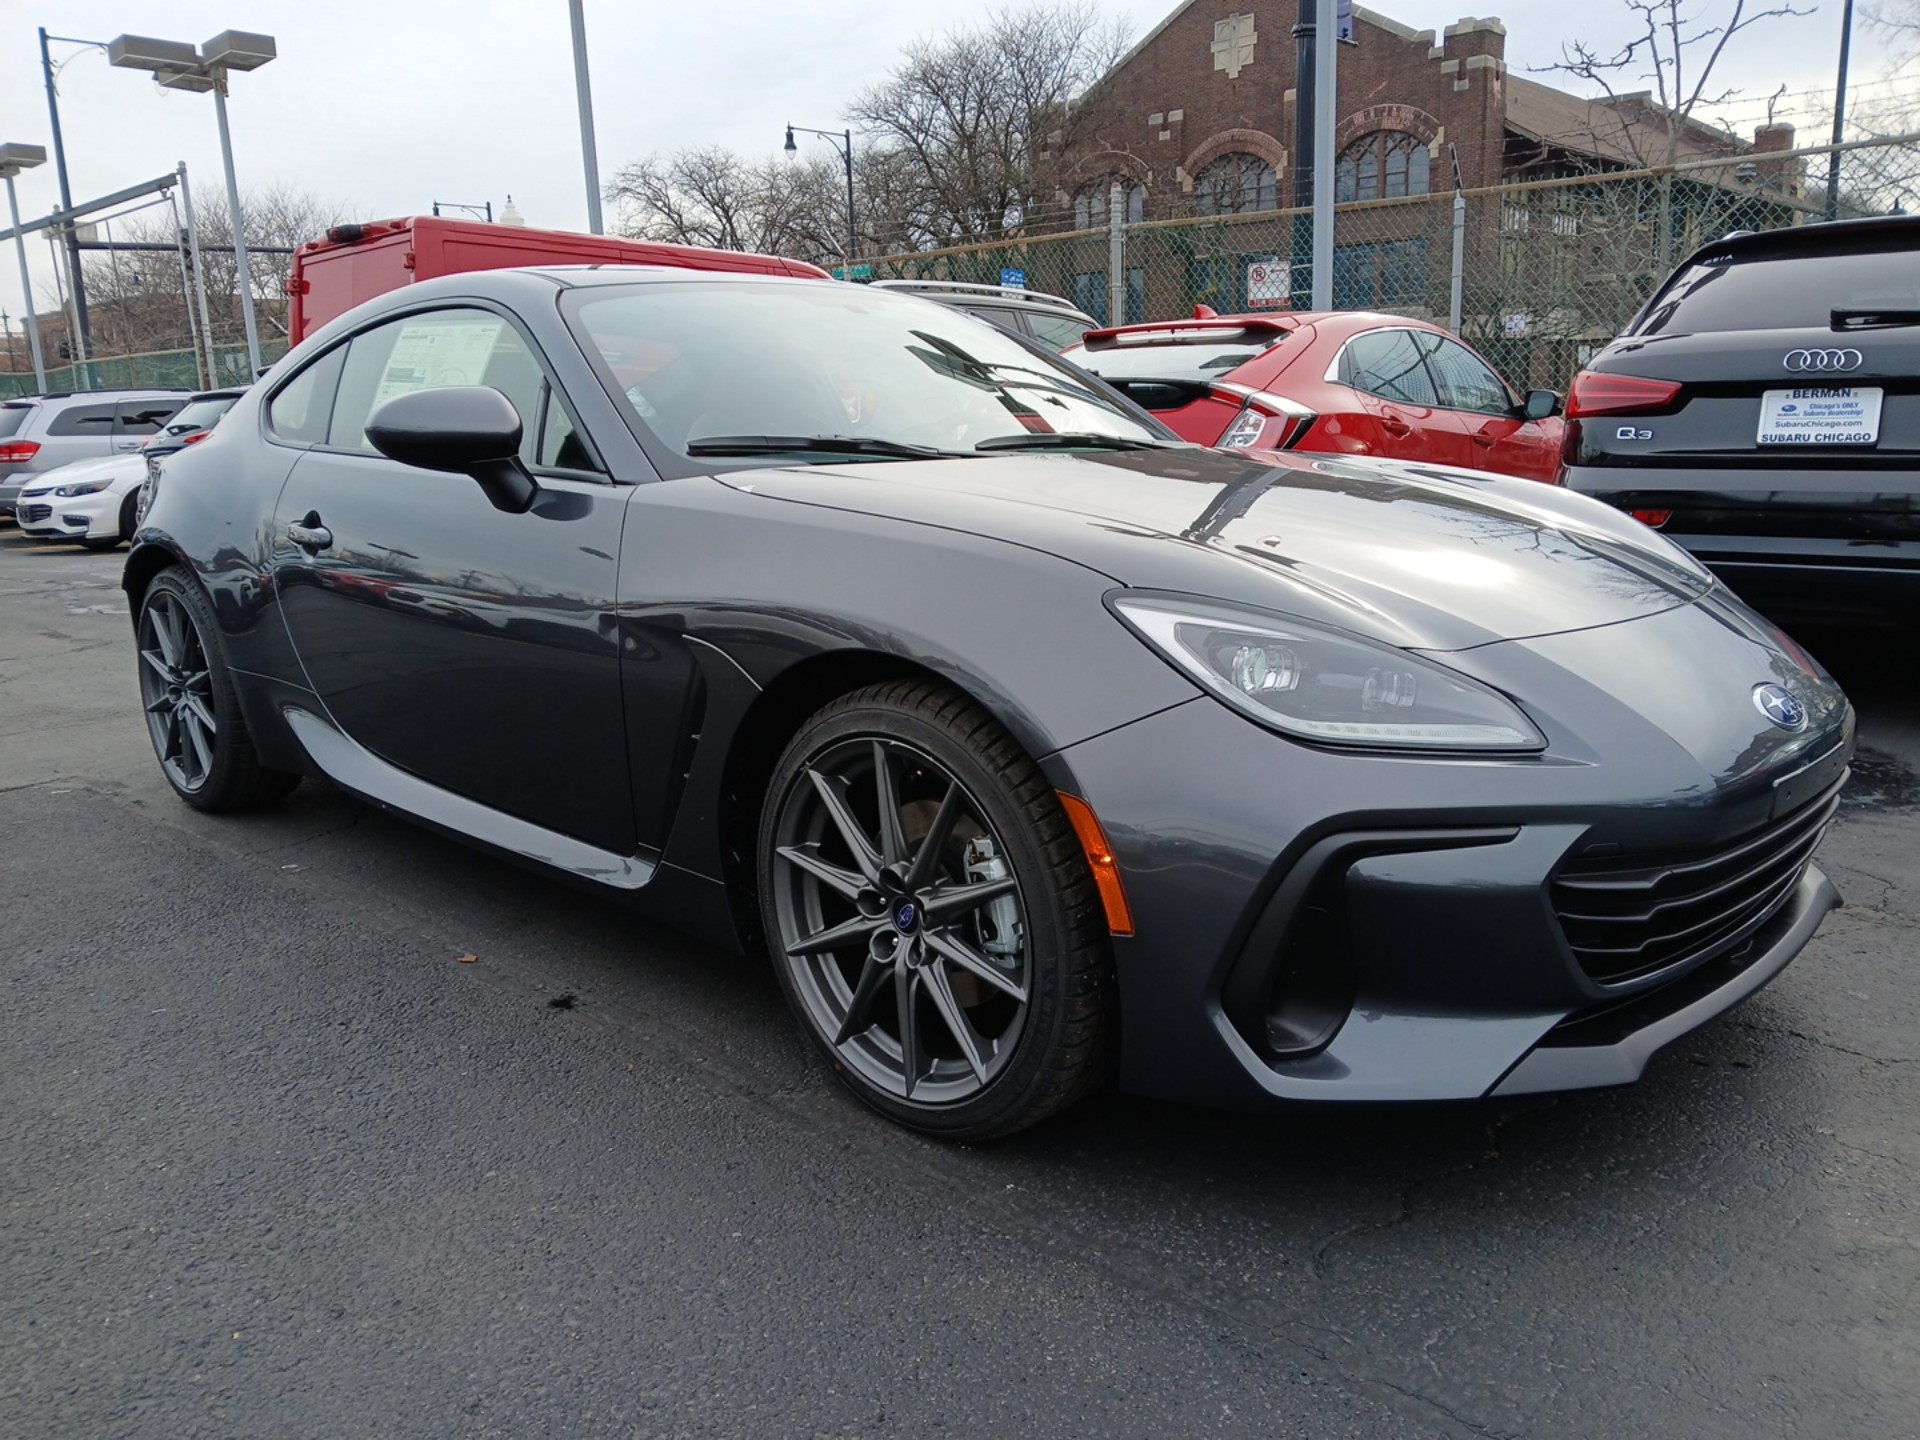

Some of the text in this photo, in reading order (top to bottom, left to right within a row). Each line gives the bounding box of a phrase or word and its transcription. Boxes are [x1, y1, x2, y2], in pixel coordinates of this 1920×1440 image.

[1792, 388, 1851, 399] BERMAN
[1809, 402, 1840, 410] Chicago's
[1775, 420, 1863, 429] SubaruChicago.com
[1616, 426, 1653, 440] Q3
[1761, 432, 1872, 442] SUBARU CHICAGO
